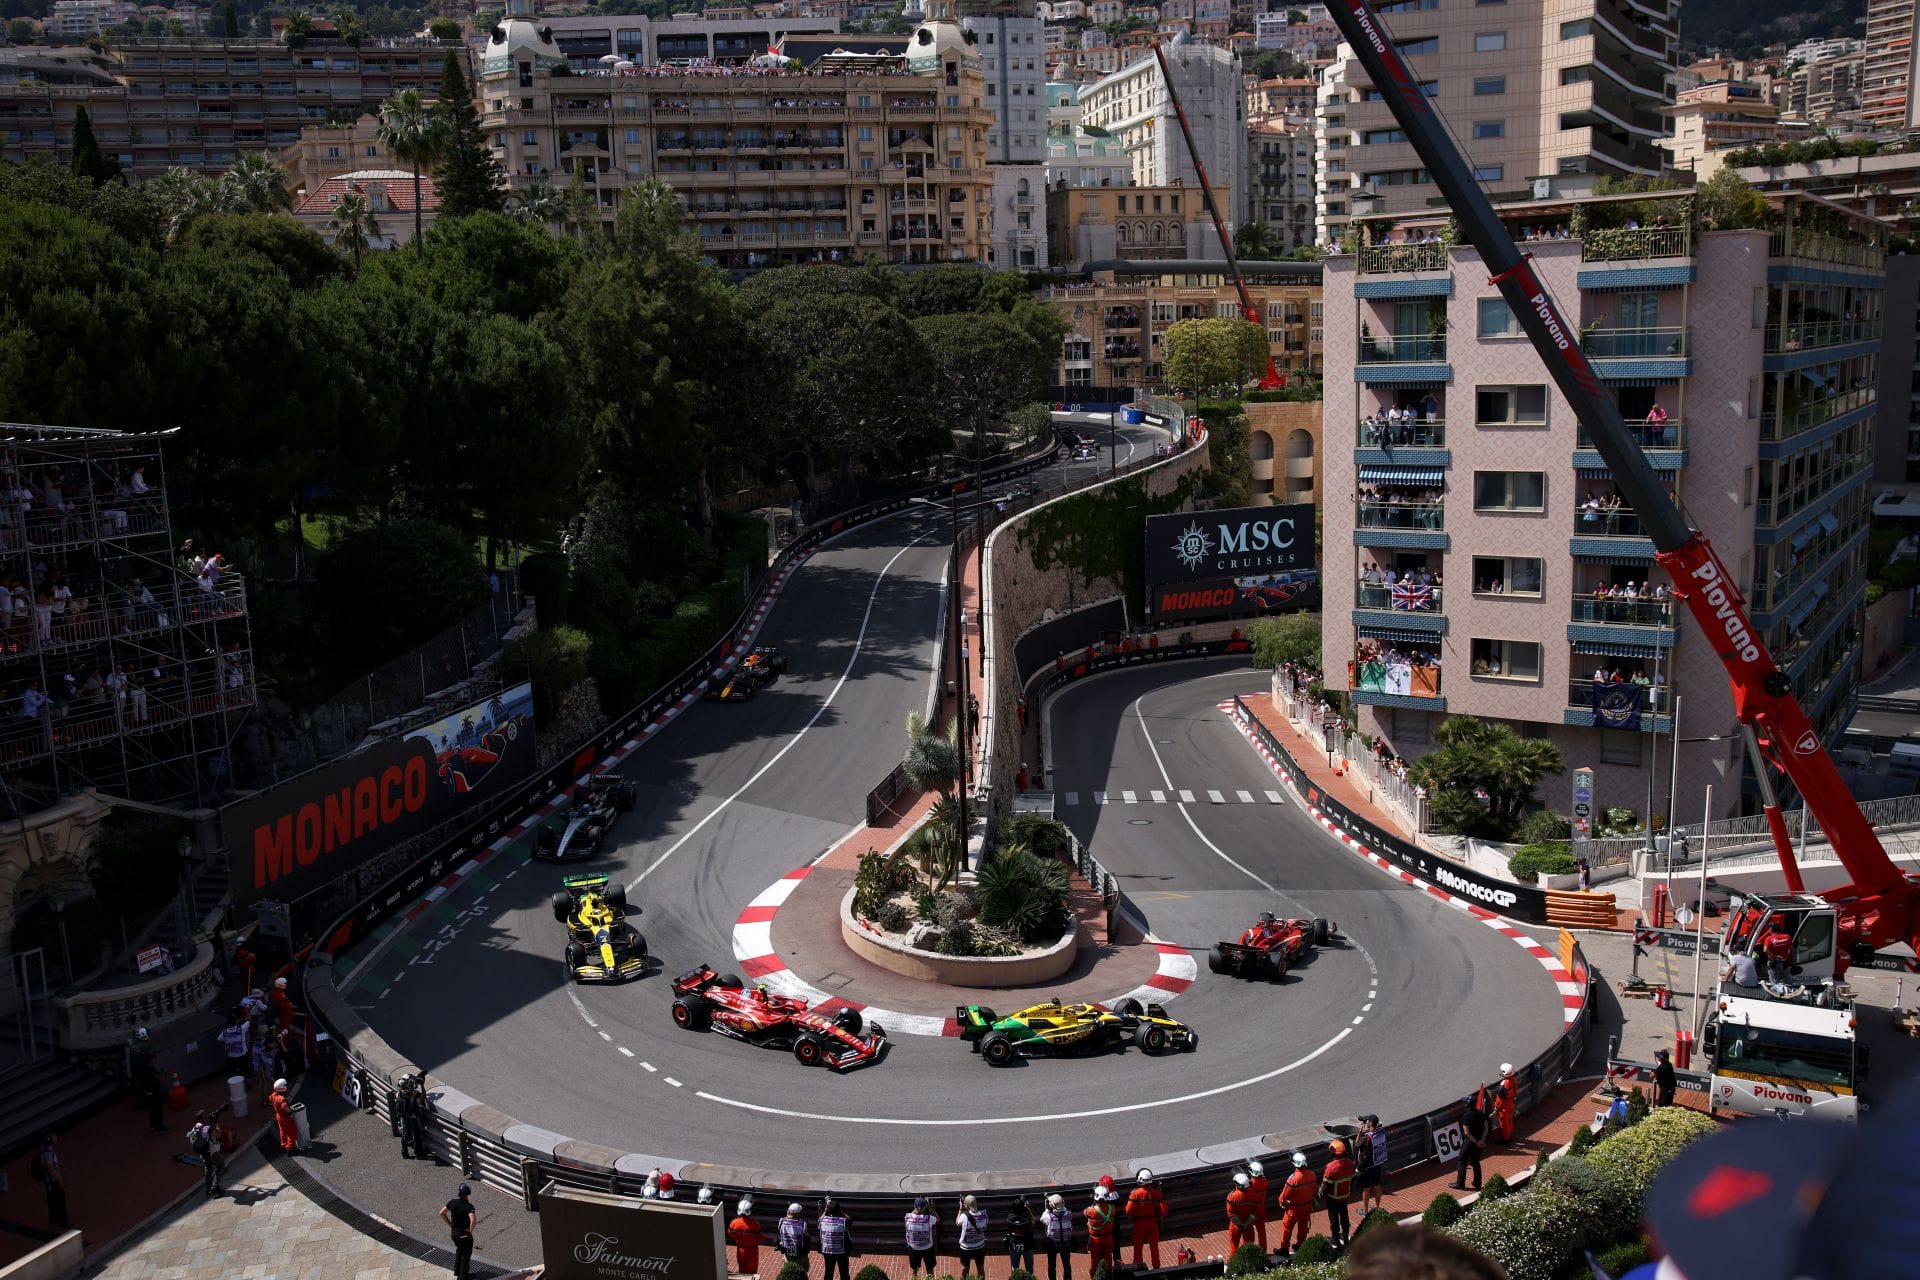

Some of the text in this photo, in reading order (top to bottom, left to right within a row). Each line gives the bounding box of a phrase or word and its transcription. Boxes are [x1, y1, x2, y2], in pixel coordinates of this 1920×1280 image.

[1353, 6, 1386, 53] Piovano
[1530, 292, 1569, 350] Piovano
[1217, 518, 1296, 555] MSC
[1217, 553, 1296, 570] CRUISES
[1161, 587, 1237, 611] MONACO
[1691, 560, 1760, 663] Piovano
[254, 755, 428, 890] MONACO
[1436, 866, 1517, 908] #MonacoGP
[1667, 938, 1709, 950] Piovao
[344, 1075, 358, 1101] SC
[1754, 1085, 1813, 1104] Piovano
[1438, 1128, 1461, 1156] SC
[574, 1231, 679, 1274] Fairmont
[598, 1267, 657, 1280] MONTE CARLO
